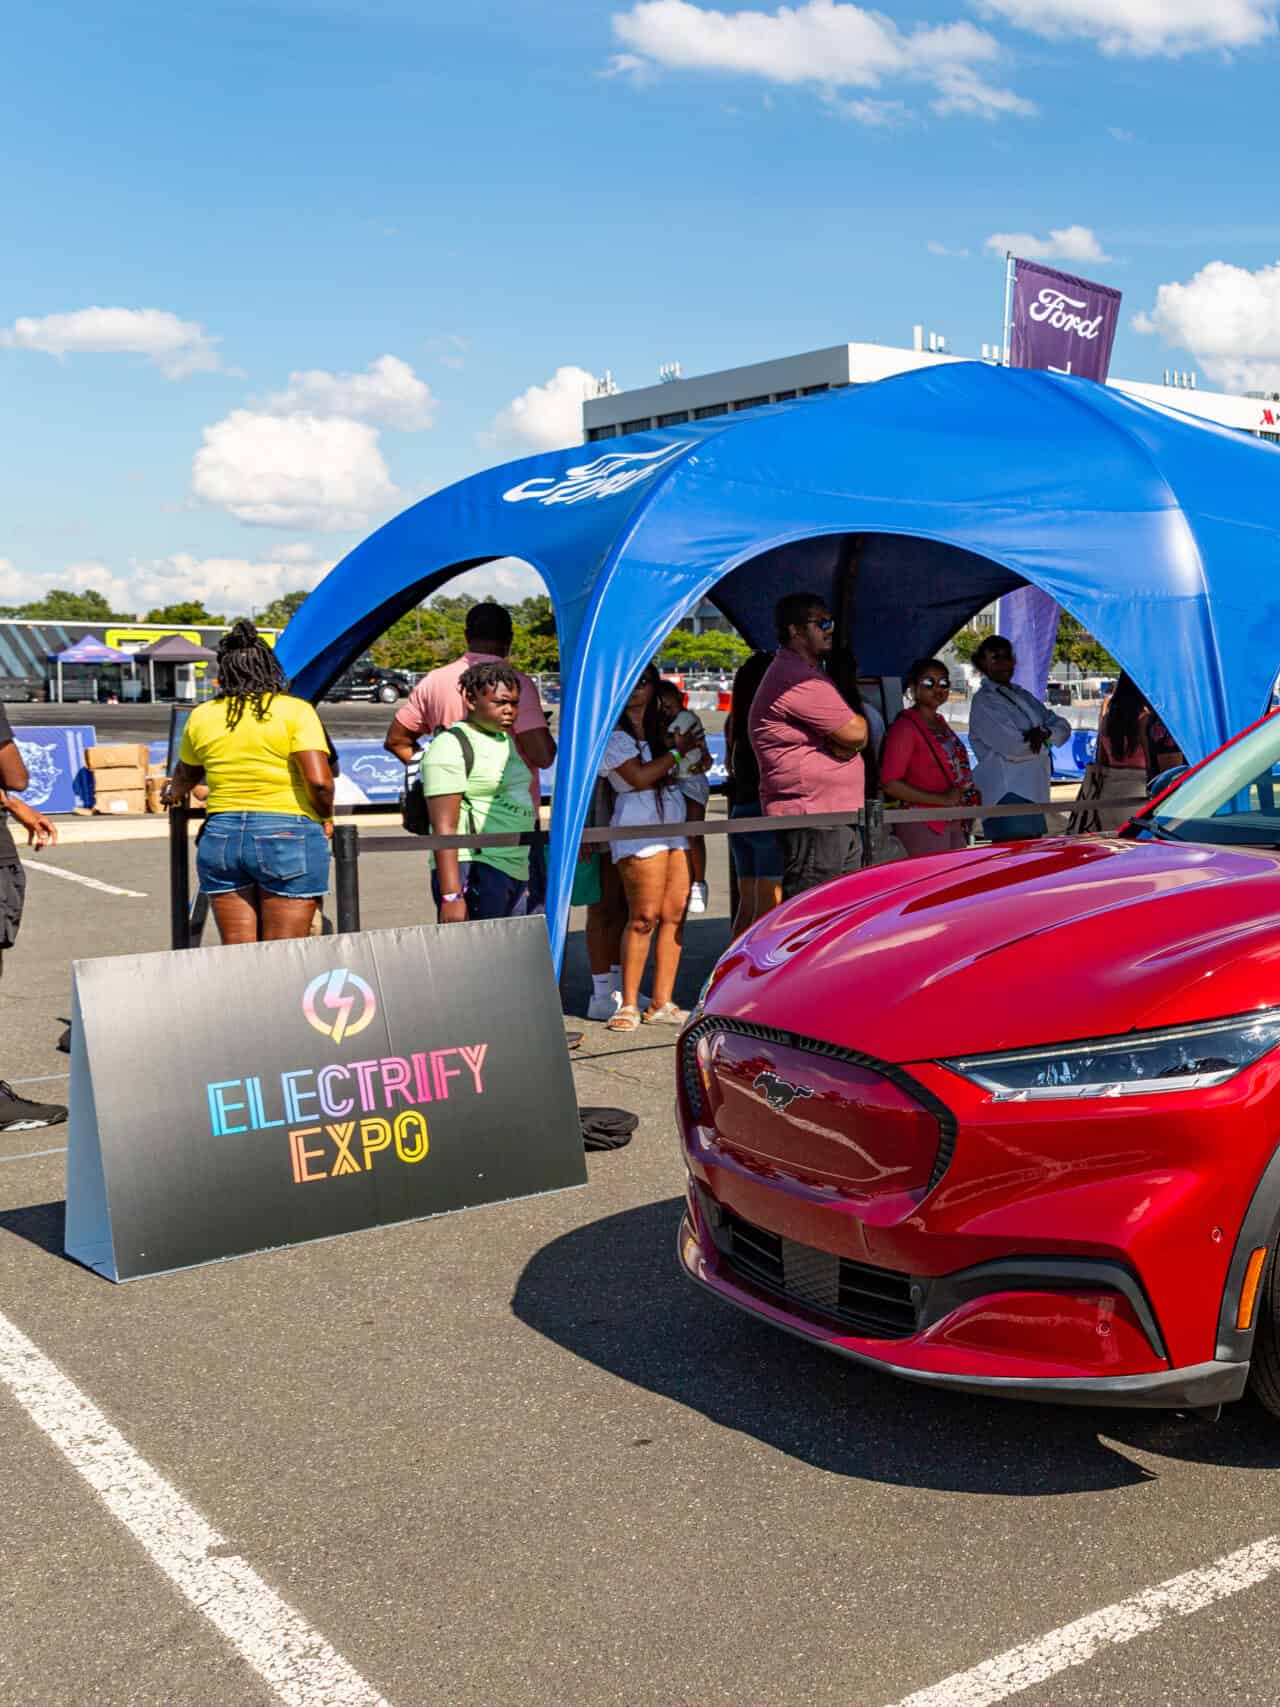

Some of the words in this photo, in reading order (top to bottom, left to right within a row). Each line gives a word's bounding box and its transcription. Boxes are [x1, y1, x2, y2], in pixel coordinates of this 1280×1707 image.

[1029, 288, 1104, 340] Ford
[207, 1043, 489, 1137] ELECTRIFY
[288, 1110, 430, 1184] EXPO
